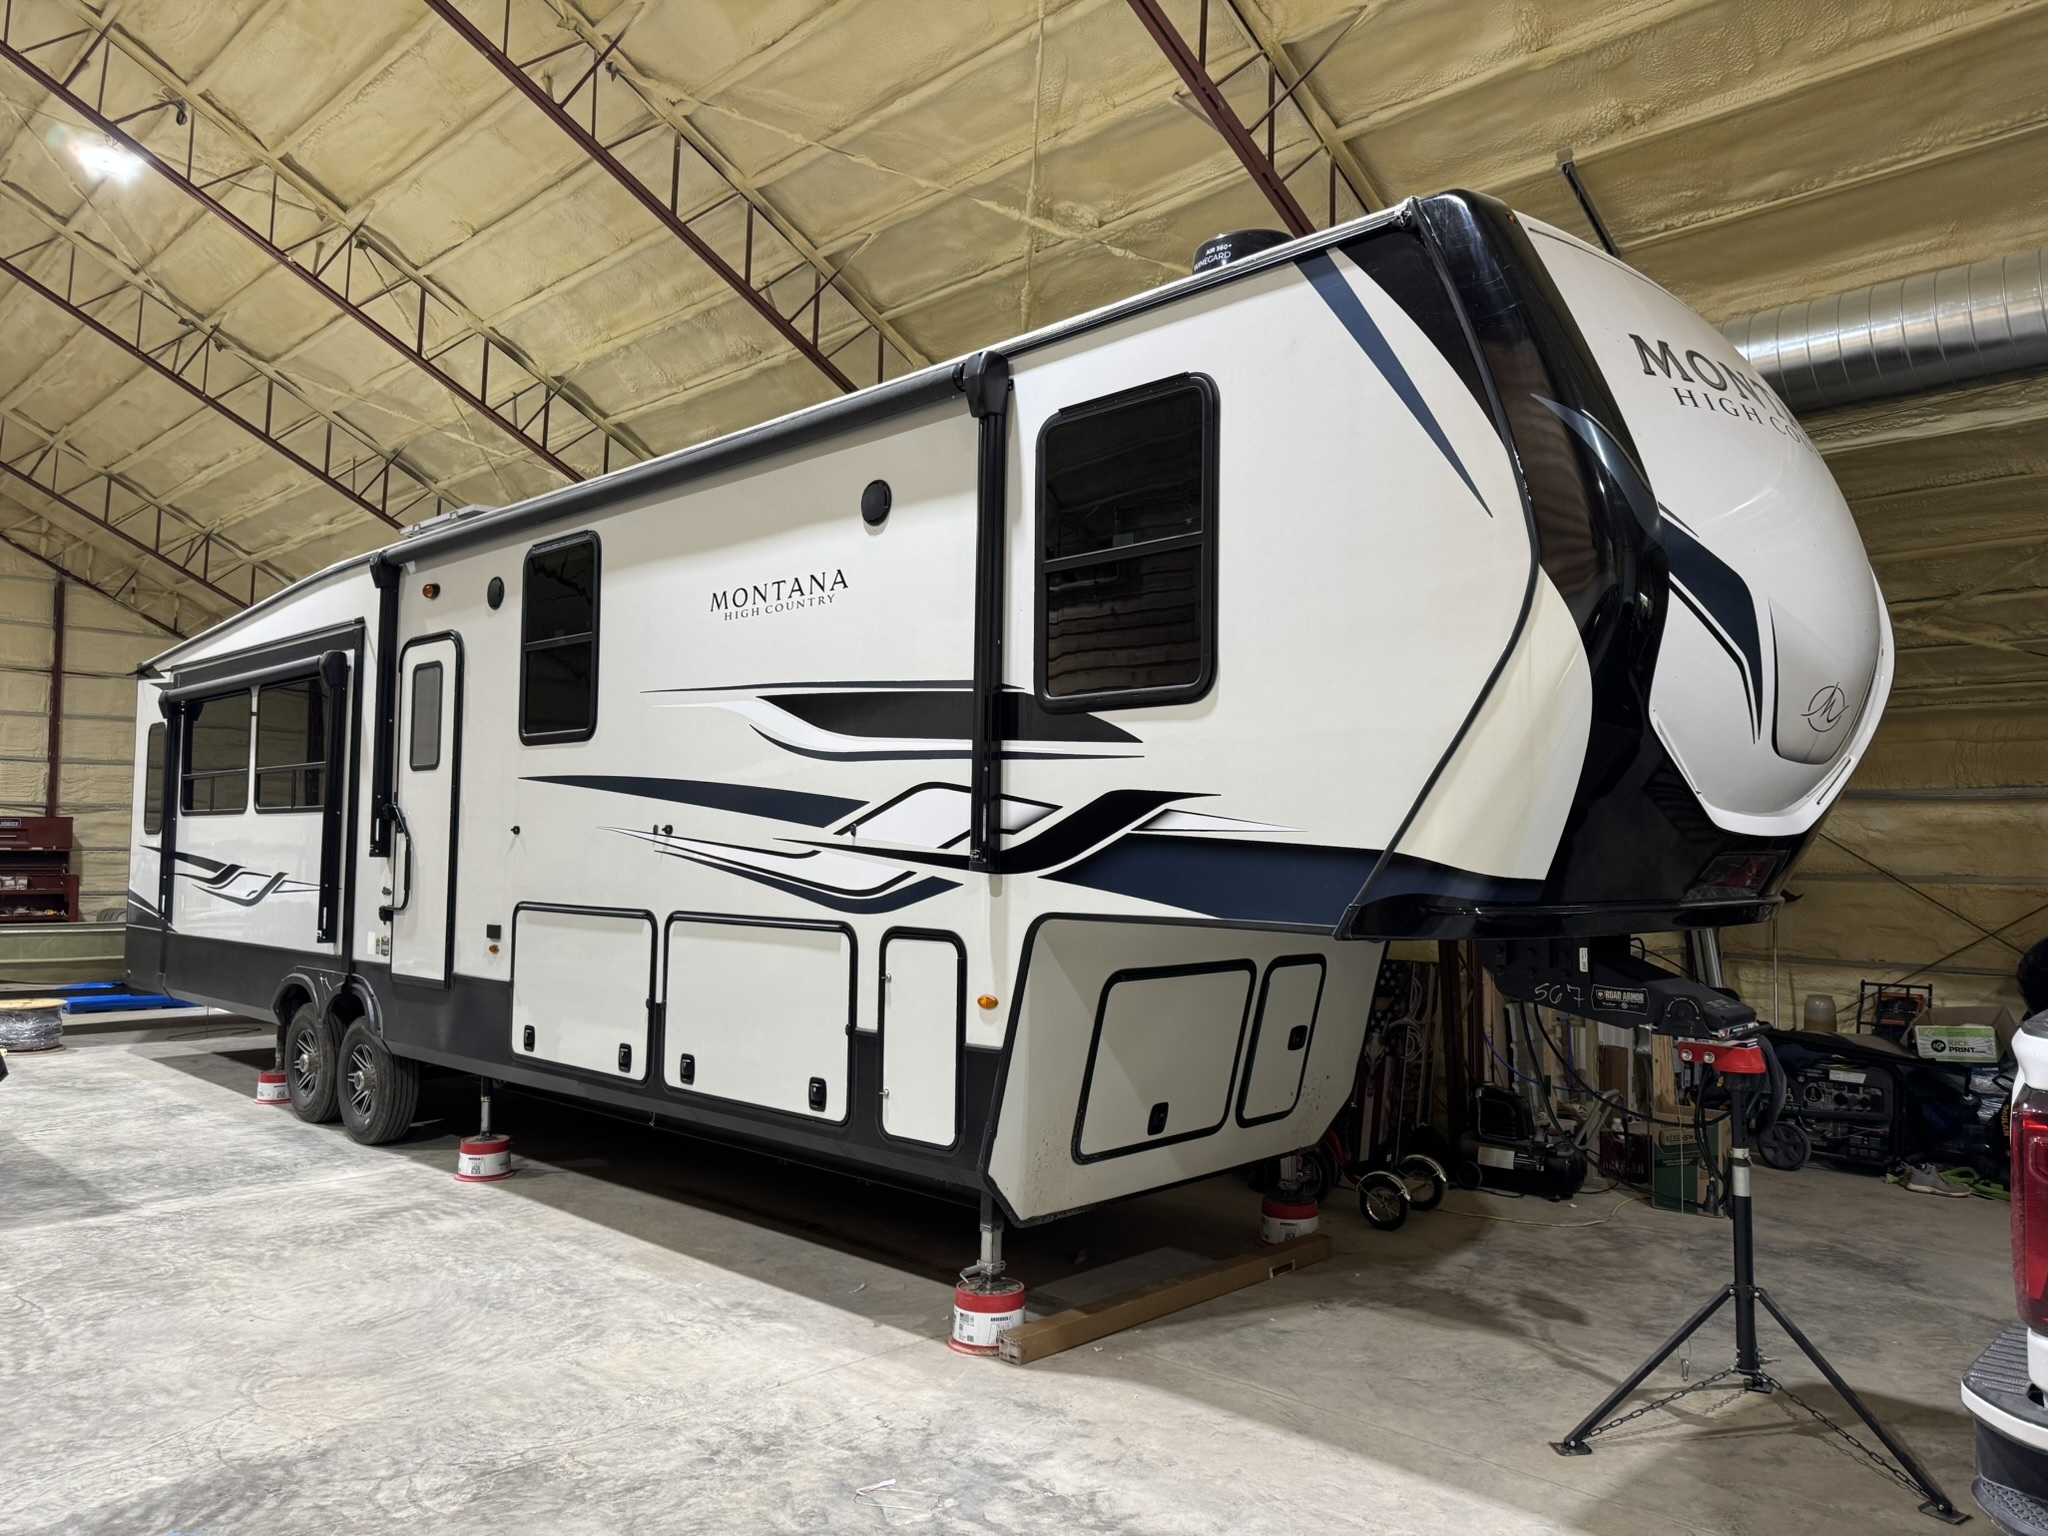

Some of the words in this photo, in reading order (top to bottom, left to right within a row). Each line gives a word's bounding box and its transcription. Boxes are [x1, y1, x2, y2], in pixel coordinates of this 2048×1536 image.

[1193, 251, 1232, 272] WINEGARD
[1205, 247, 1216, 256] AIR
[1627, 333, 1797, 422] MONT
[1670, 386, 1765, 425] HIGH
[710, 569, 849, 612] MONTANA
[724, 607, 760, 621] HIGH
[765, 594, 835, 614] COUNTRY
[1605, 990, 1622, 1000] ROAD
[1622, 991, 1645, 1002] ARMOR
